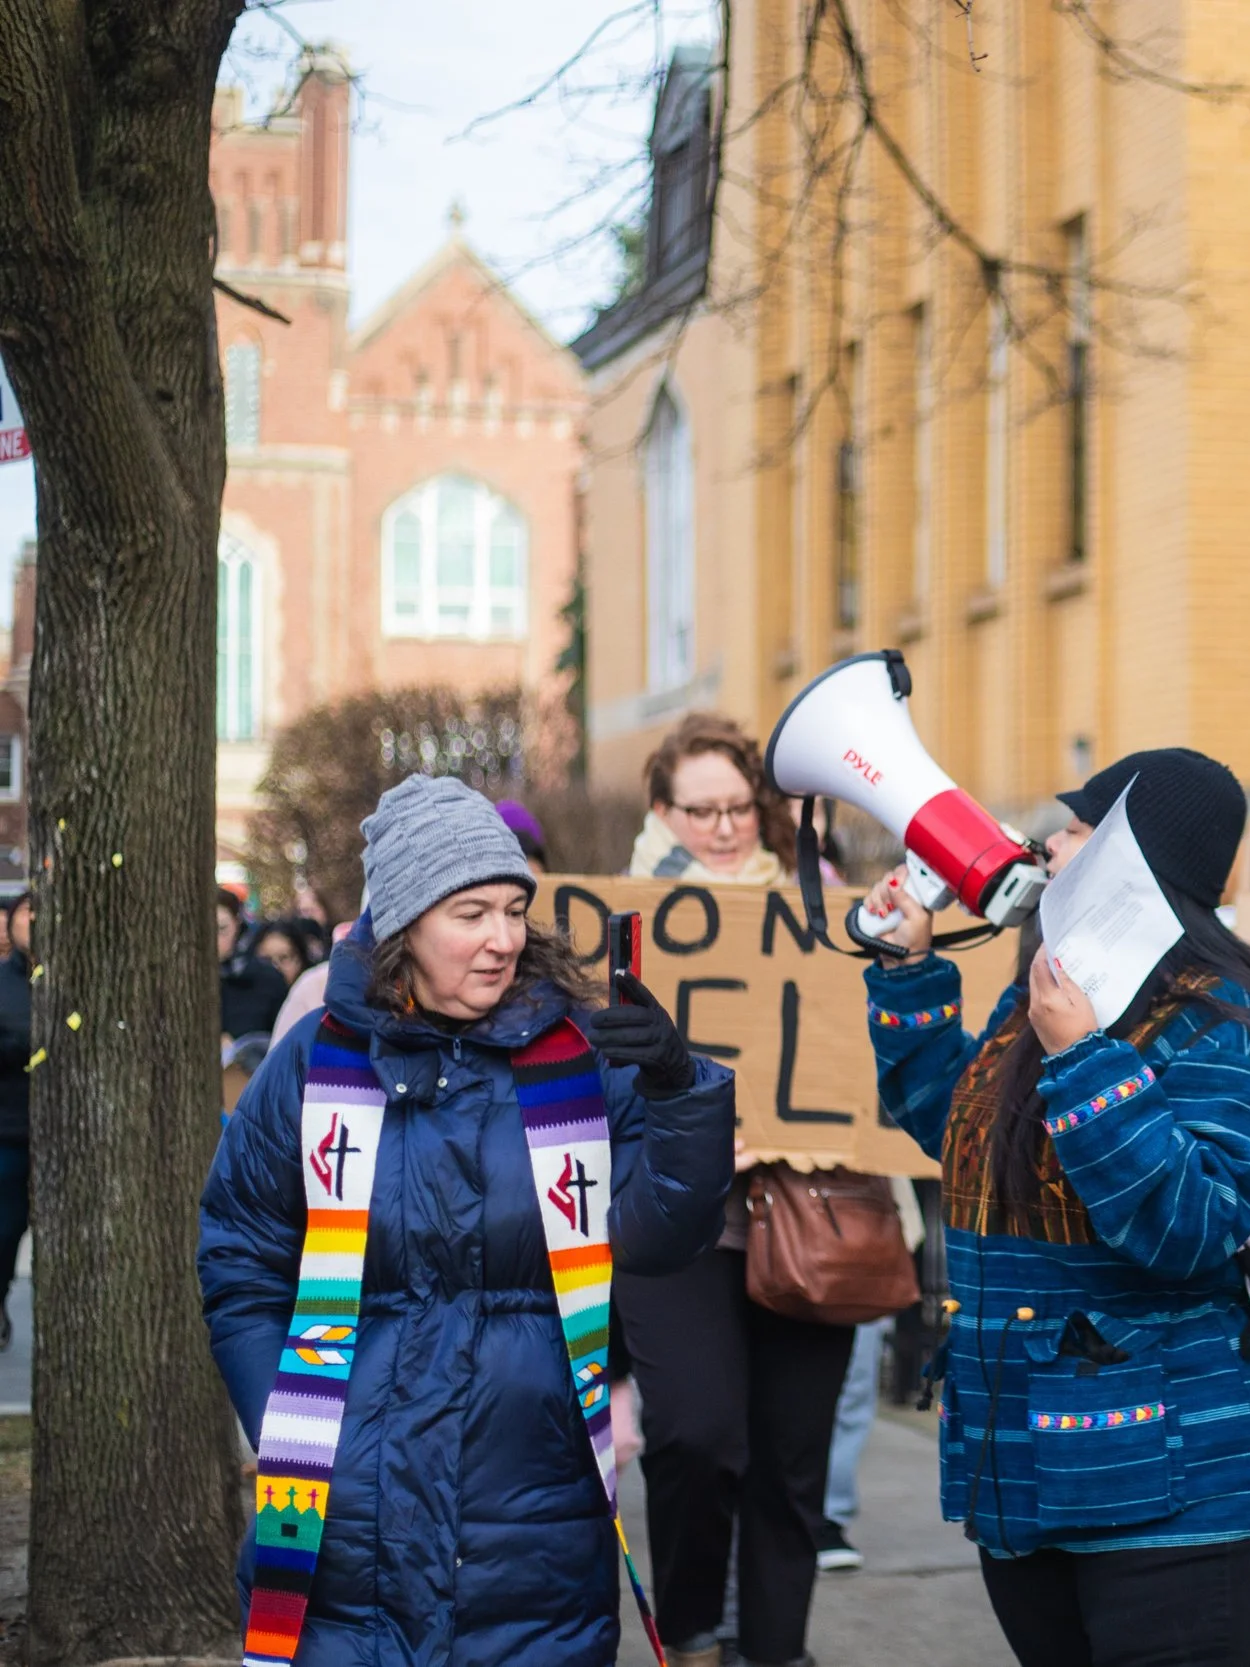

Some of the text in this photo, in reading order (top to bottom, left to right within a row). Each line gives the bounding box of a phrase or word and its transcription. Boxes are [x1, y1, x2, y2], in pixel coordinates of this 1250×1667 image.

[842, 747, 883, 787] PYLE
[553, 884, 862, 964] DON
[675, 977, 902, 1130] EL
